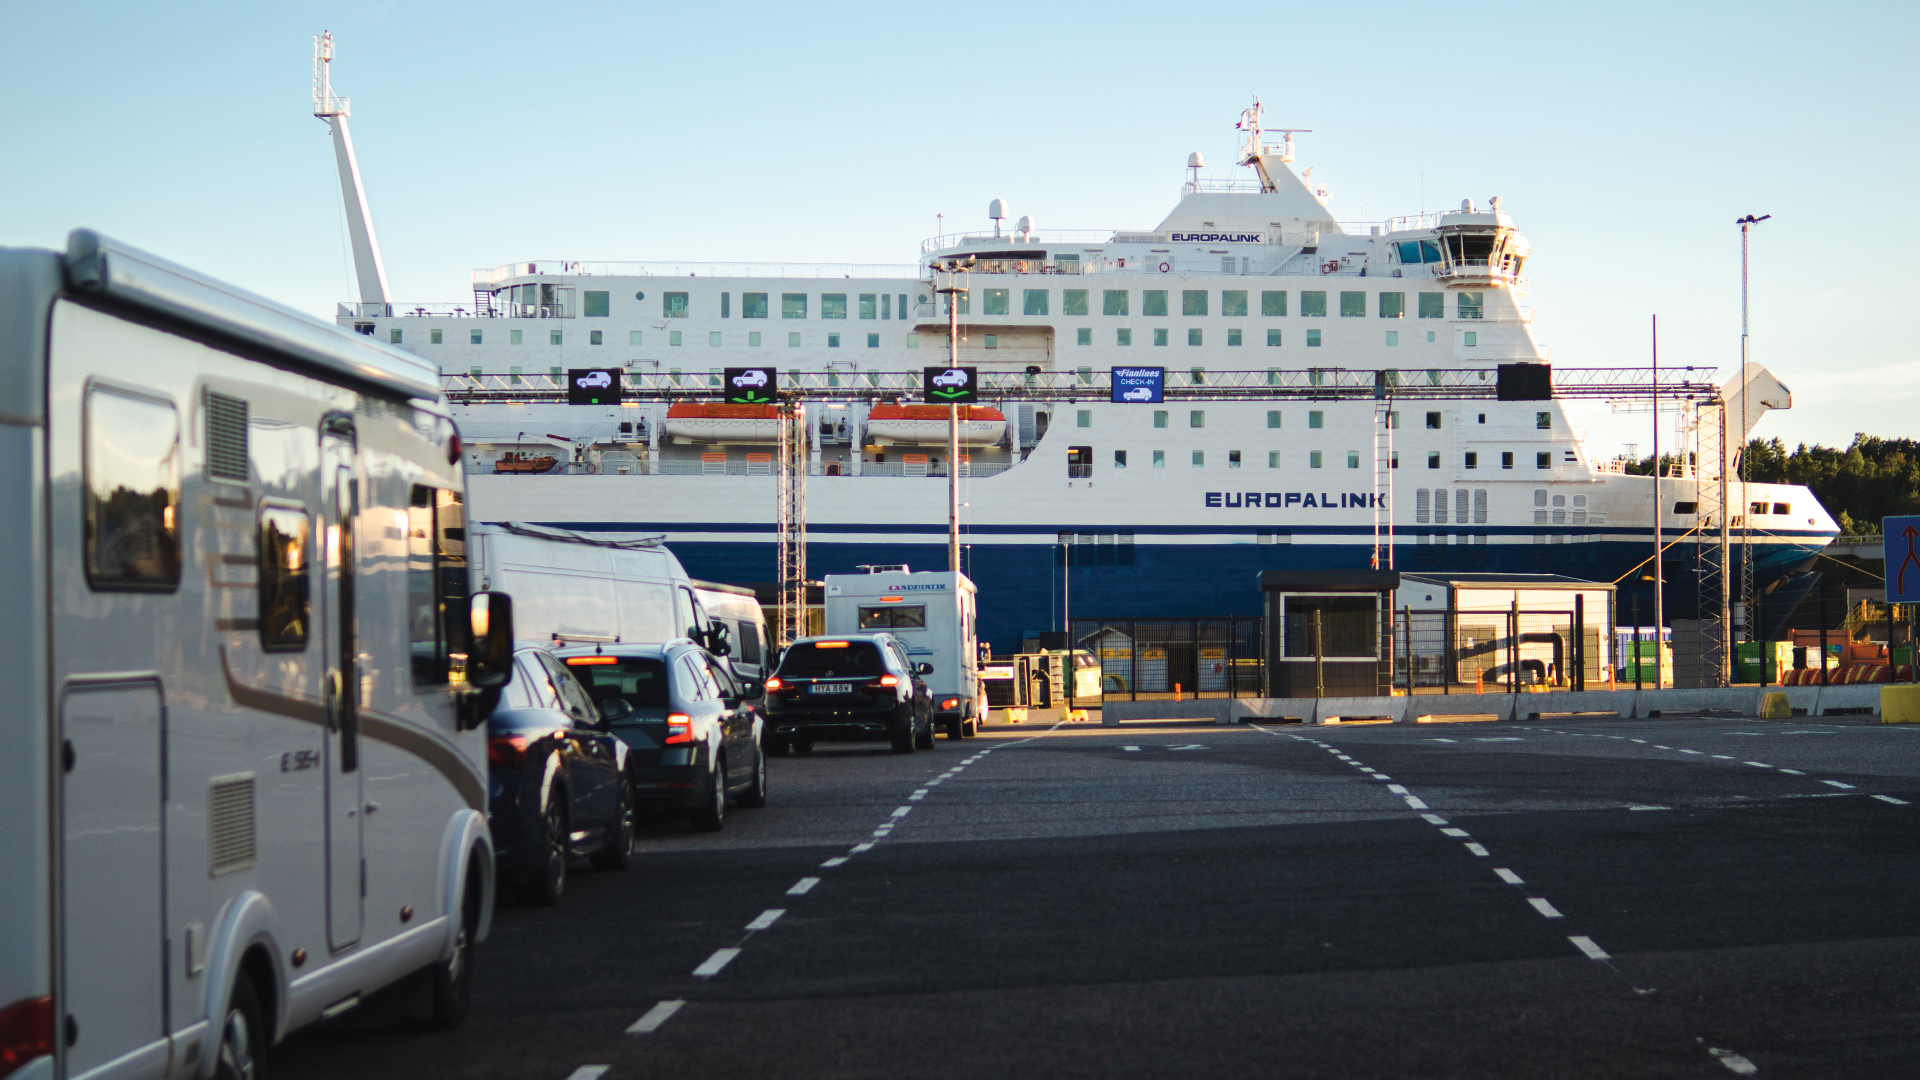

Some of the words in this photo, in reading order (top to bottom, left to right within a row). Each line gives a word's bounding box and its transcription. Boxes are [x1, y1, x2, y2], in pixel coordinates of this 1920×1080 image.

[1171, 233, 1261, 243] EUROPALINK
[1120, 369, 1160, 377] Finnlines
[1205, 492, 1386, 508] EUROPALINK
[815, 684, 831, 692] HYA
[833, 684, 849, 692] 88W
